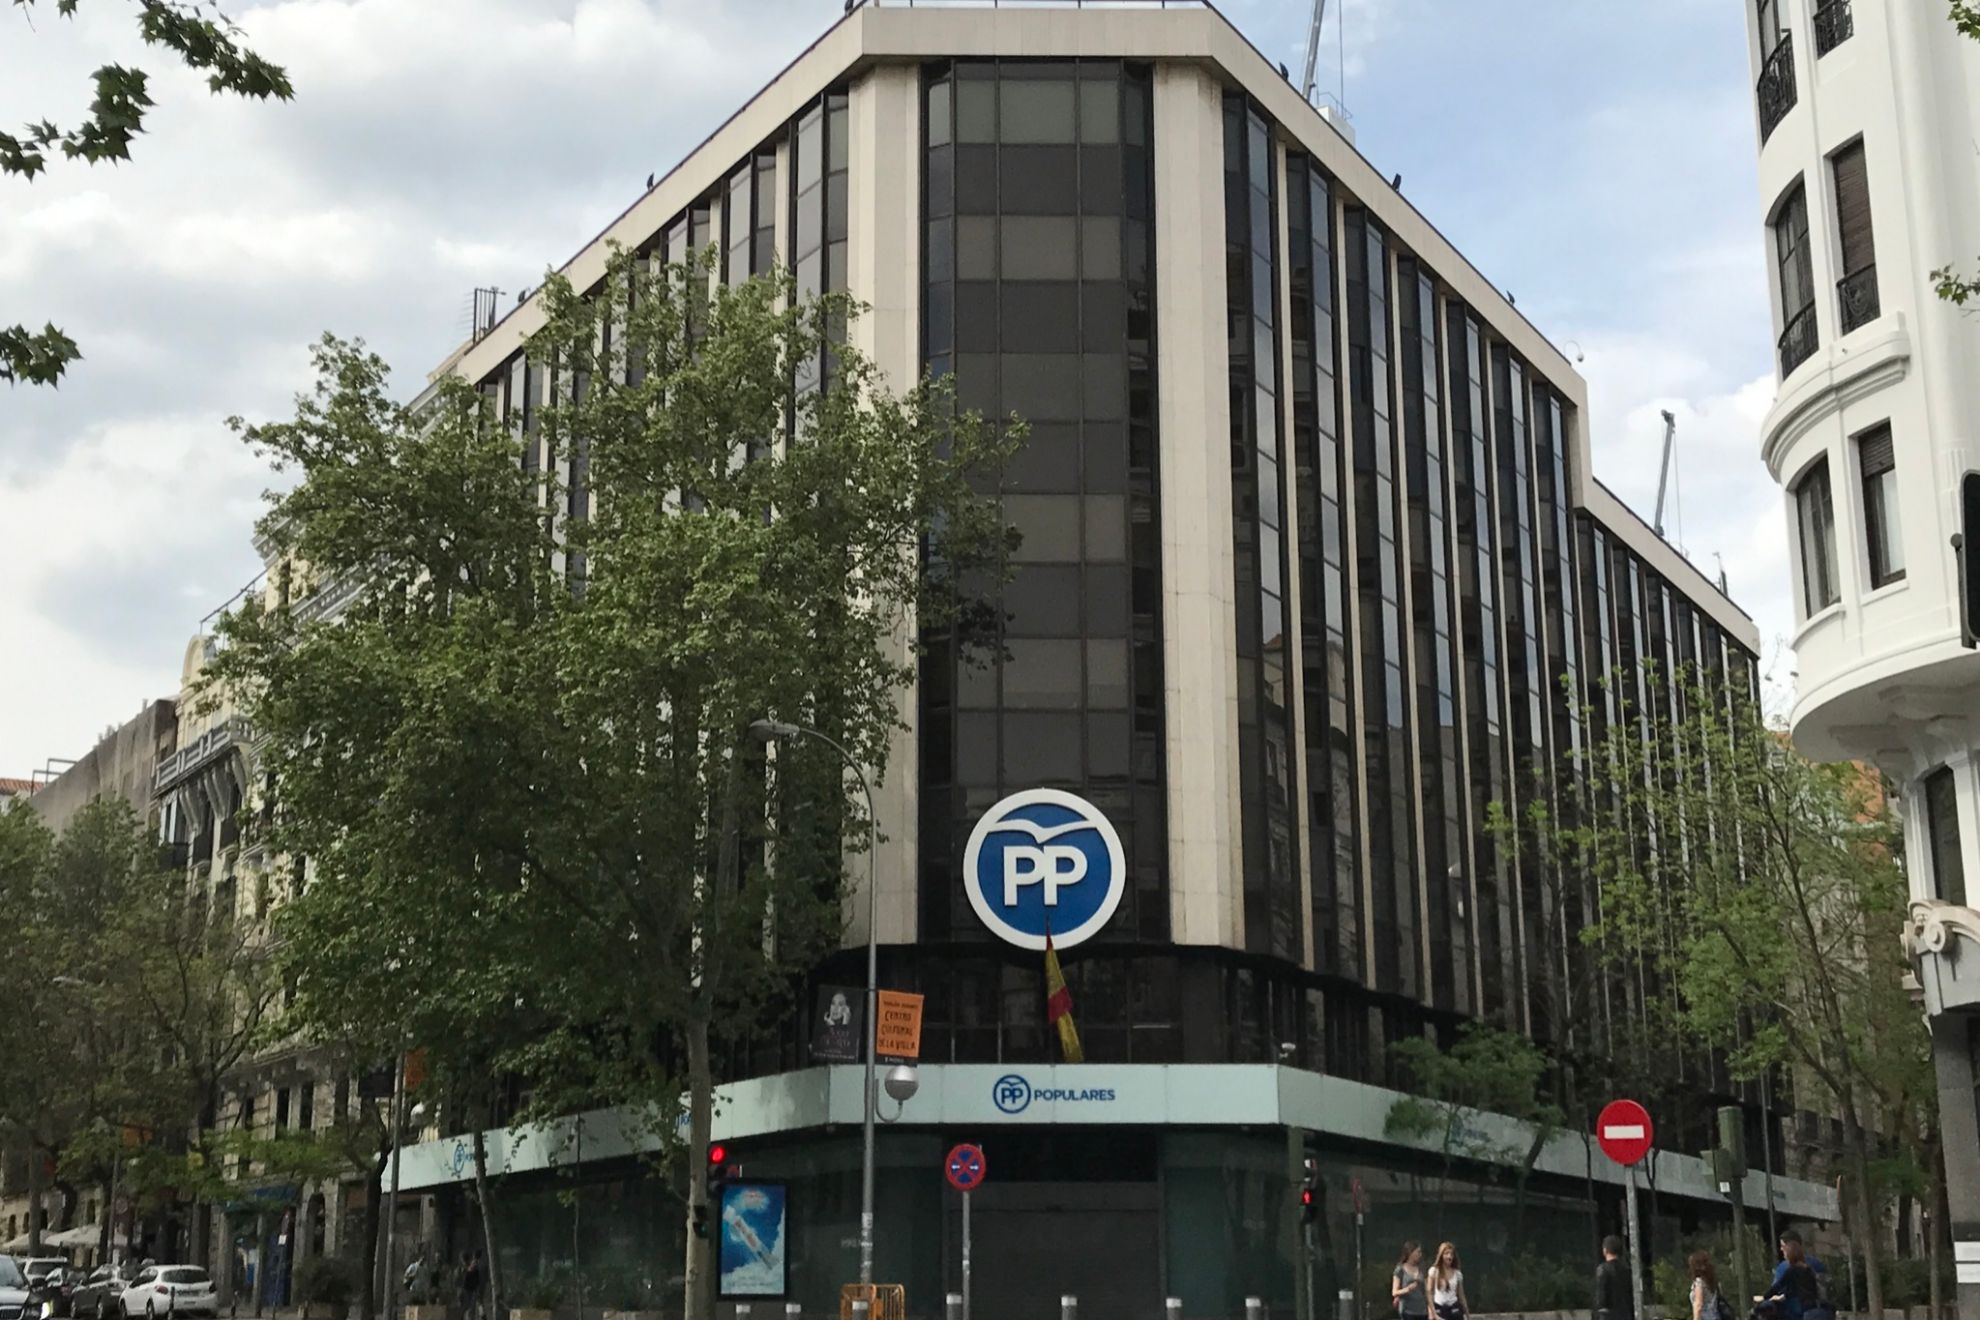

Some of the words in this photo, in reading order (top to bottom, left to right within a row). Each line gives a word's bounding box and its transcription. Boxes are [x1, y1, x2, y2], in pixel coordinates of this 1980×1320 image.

[1003, 845, 1088, 906] PP
[1001, 1087, 1024, 1104] PP
[1034, 1089, 1116, 1101] POPULARES
